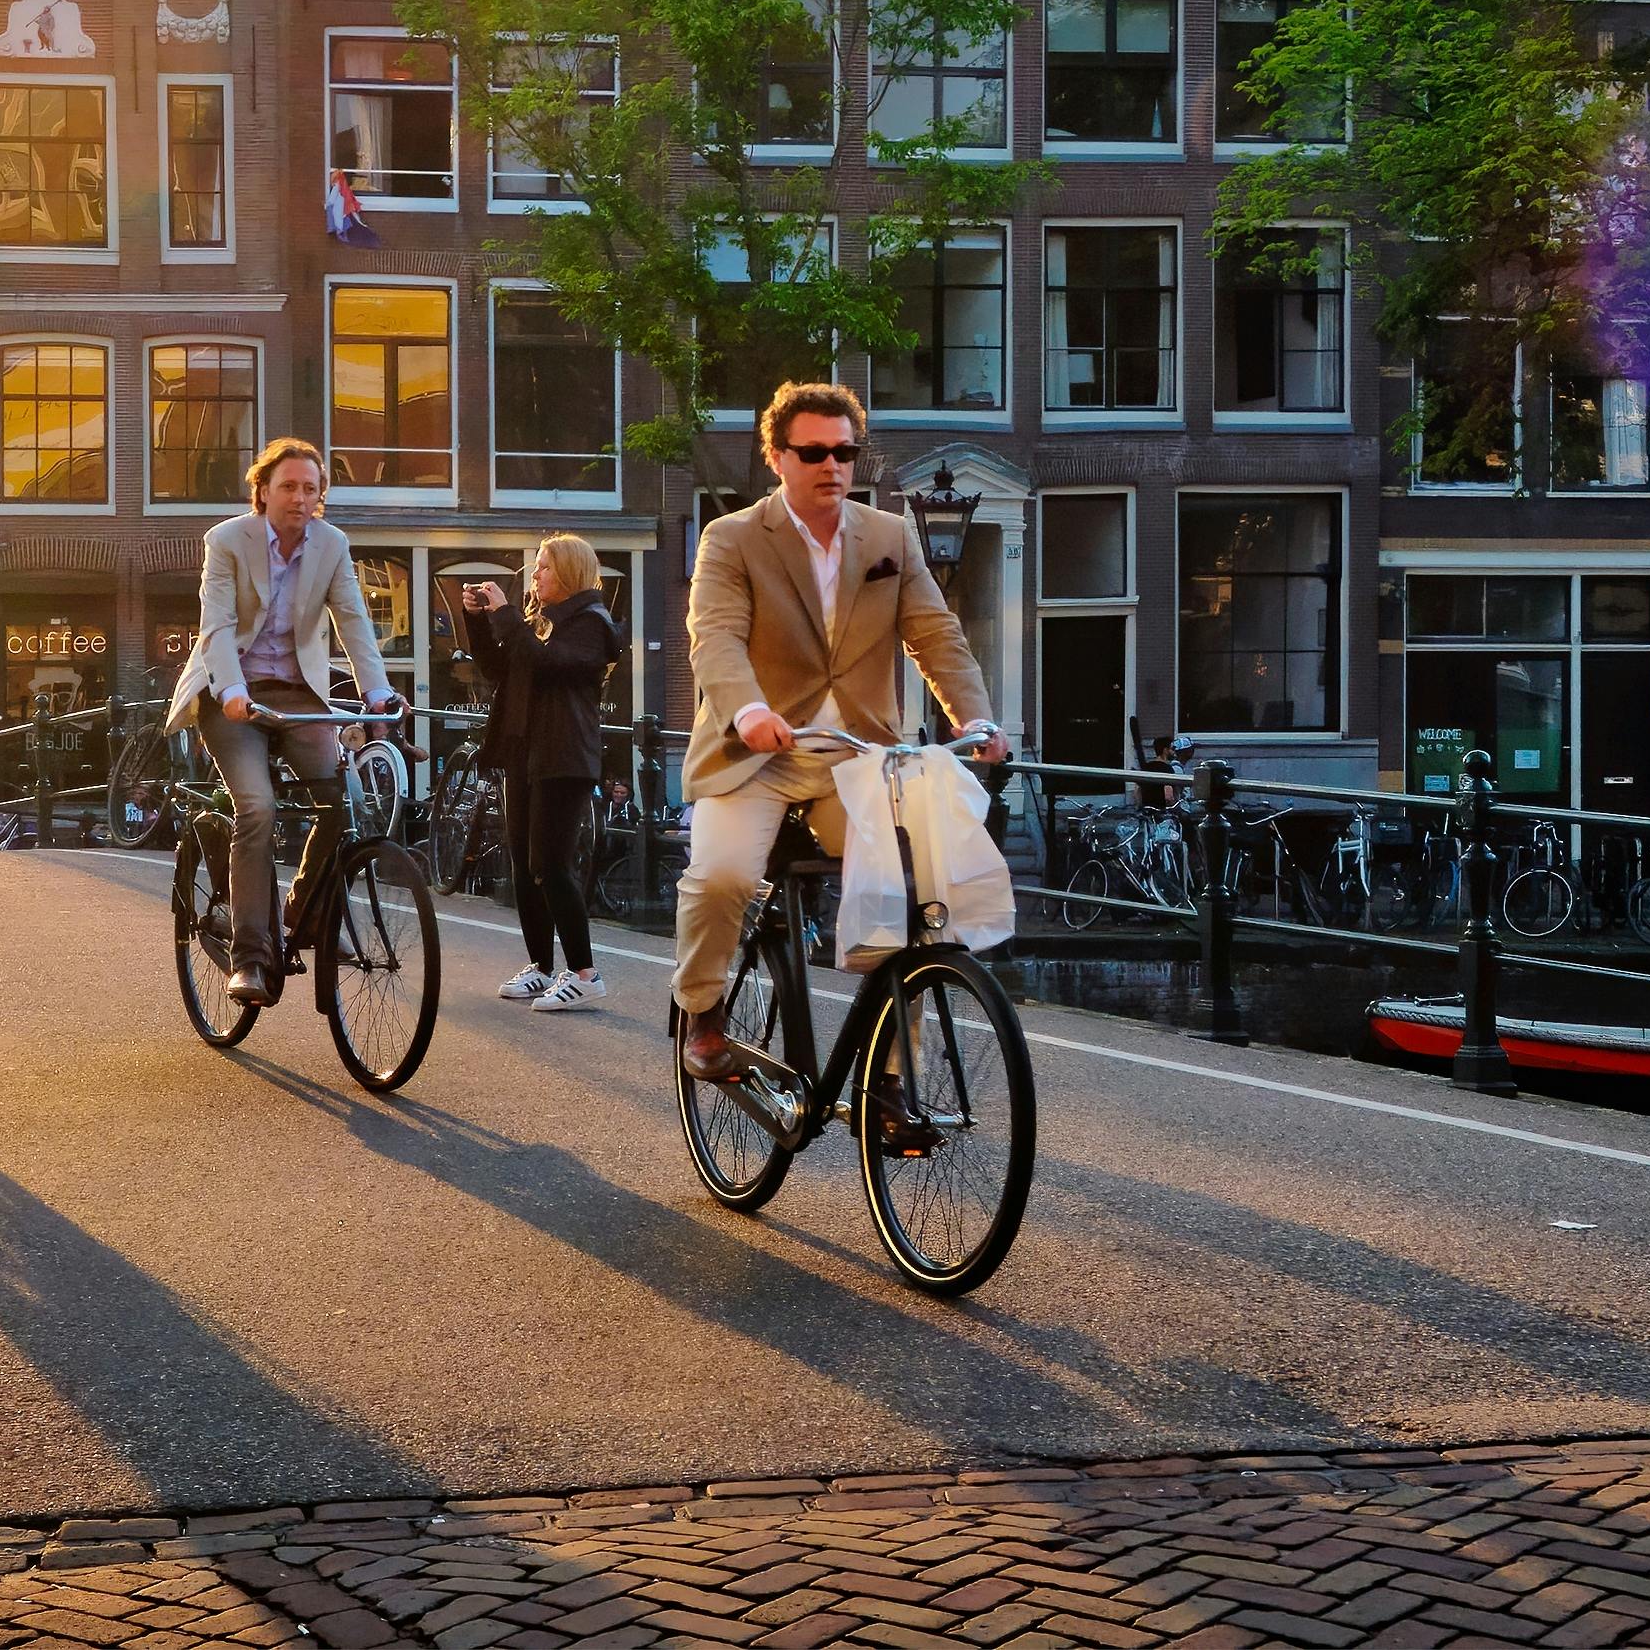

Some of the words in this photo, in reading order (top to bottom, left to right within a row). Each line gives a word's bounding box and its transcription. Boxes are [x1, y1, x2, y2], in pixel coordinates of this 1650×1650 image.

[7, 631, 107, 654] coffee
[165, 631, 201, 653] sh
[1418, 728, 1463, 741] WELCOME
